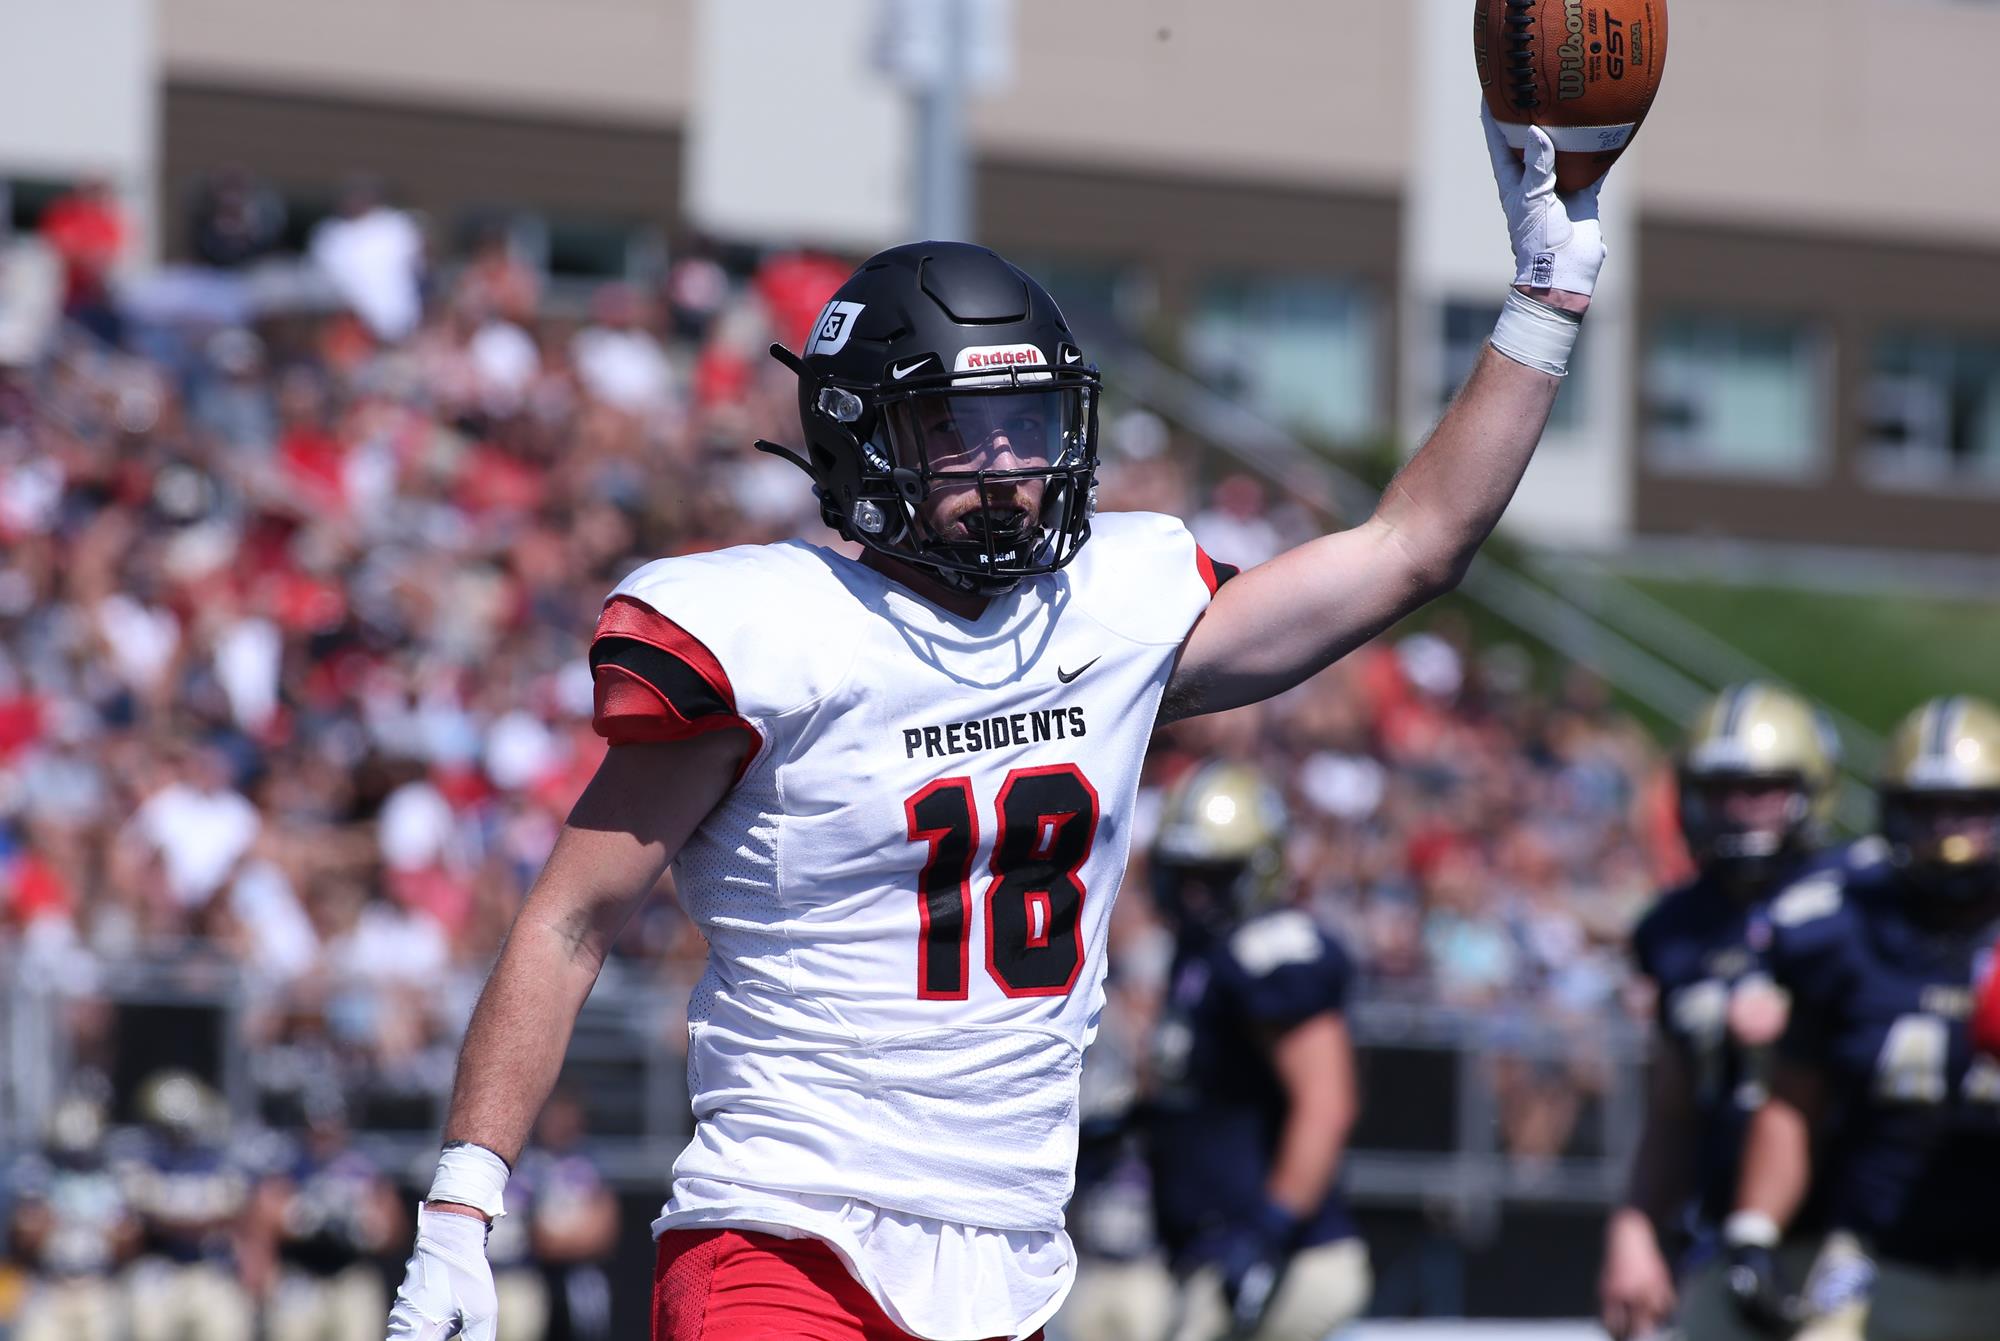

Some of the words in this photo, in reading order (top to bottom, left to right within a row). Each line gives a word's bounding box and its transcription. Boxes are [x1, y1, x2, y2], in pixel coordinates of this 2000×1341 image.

[1557, 0, 1585, 101] Wilson
[1604, 8, 1624, 80] GST
[968, 349, 1038, 367] Riddell
[980, 550, 1016, 563] Rddell
[903, 707, 1087, 758] PRESIDENTS
[904, 762, 1100, 1000] 18
